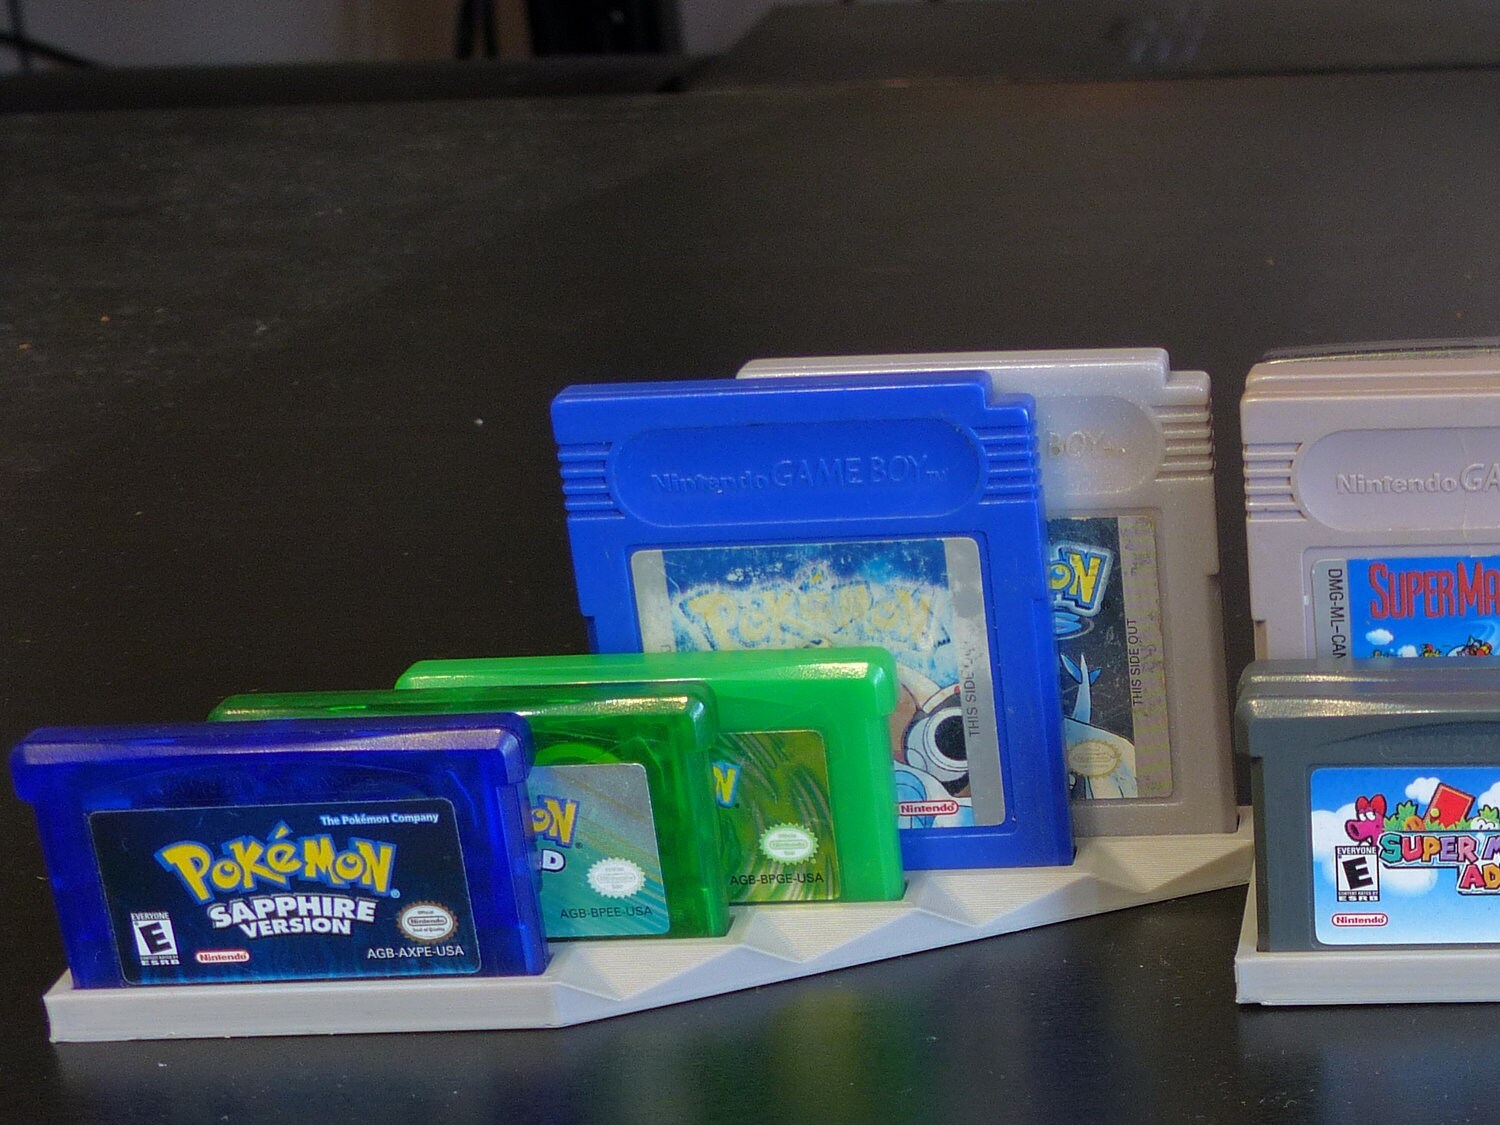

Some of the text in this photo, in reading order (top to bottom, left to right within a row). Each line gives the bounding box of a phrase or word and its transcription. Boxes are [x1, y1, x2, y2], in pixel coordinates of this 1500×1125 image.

[651, 470, 769, 494] Nintendo
[770, 457, 863, 488] GAME
[870, 453, 928, 483] BOY
[1336, 472, 1458, 495] Nintendo
[1127, 618, 1142, 706] THIS SIDE OUT
[967, 706, 981, 738] THIS
[901, 802, 955, 813] Nintendo
[320, 813, 439, 826] The Pokémon Company
[1337, 847, 1377, 855] EVERYONE
[1380, 832, 1478, 864] SUPER
[730, 873, 824, 885] AGB-BPGE-USA
[1342, 856, 1373, 890] E
[130, 911, 169, 921] EVERYONE
[207, 892, 378, 929] SAPPHIRE
[560, 906, 653, 918] AGB-BPEE-USA
[1336, 915, 1384, 924] Nintendo
[238, 916, 353, 939] VERSION
[138, 922, 172, 955] E
[200, 952, 247, 962] Nintendo
[367, 944, 465, 959] AGB-AXPE-USA
